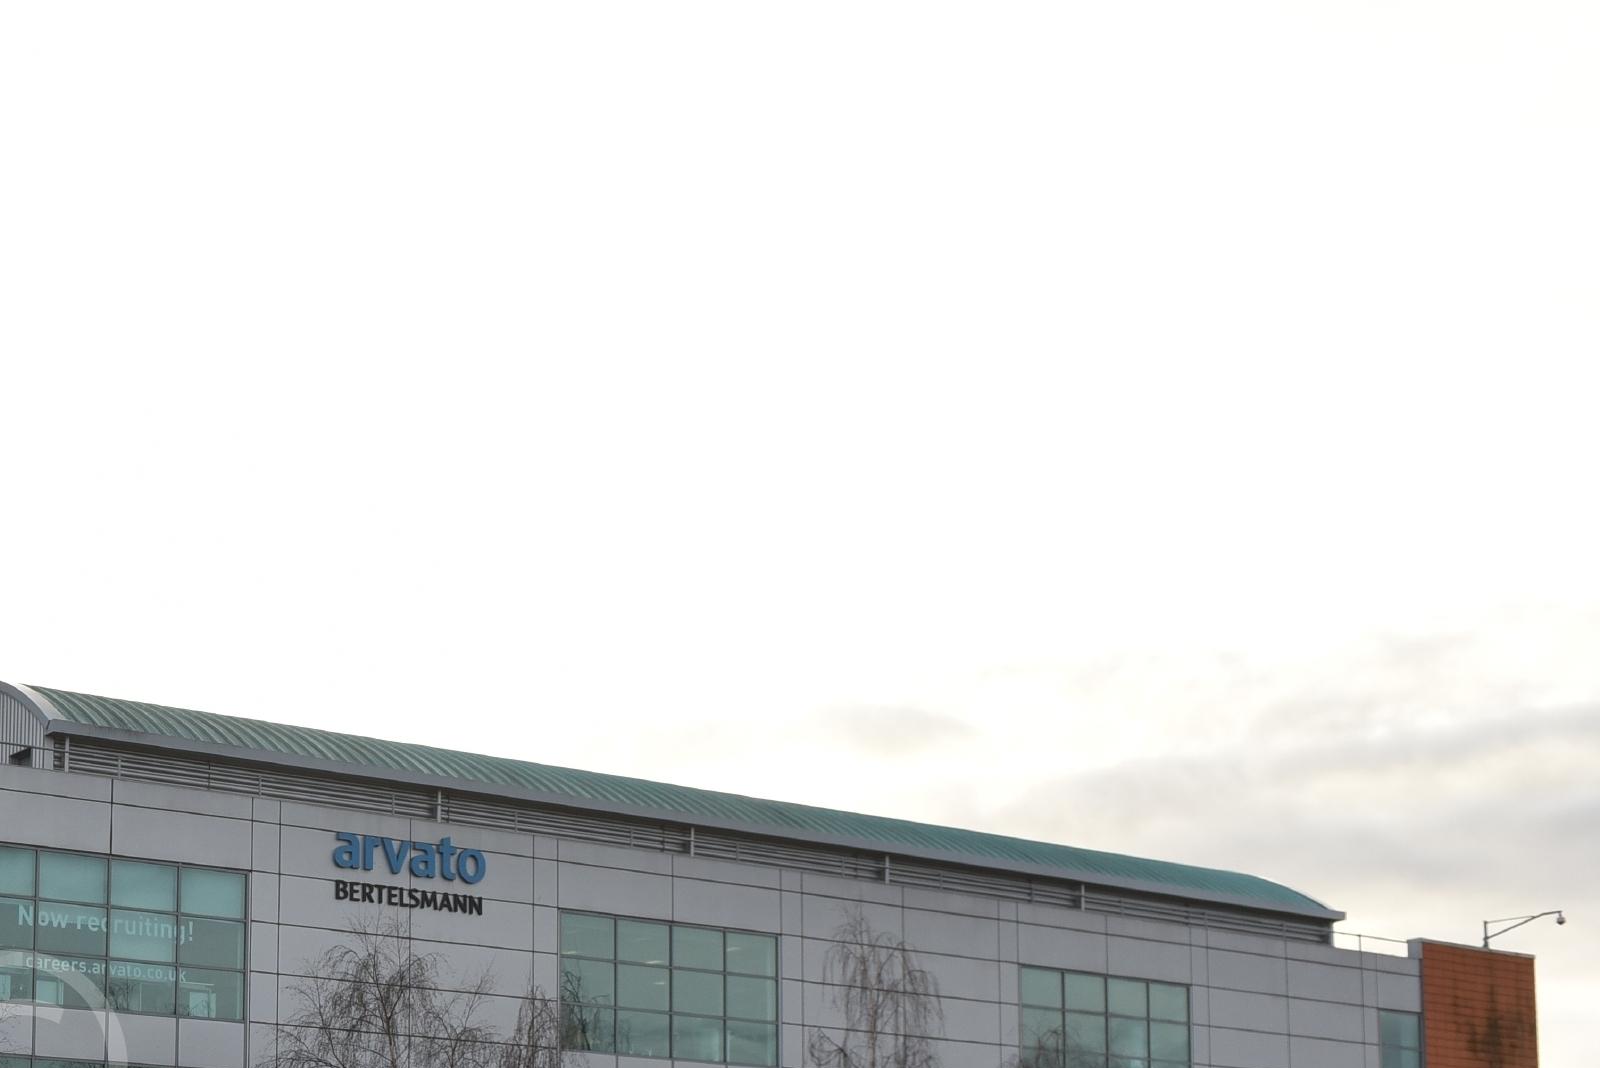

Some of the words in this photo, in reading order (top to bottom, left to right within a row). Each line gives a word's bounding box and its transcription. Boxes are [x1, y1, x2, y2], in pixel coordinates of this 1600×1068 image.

[333, 831, 487, 884] arvato
[335, 879, 483, 916] BERTELSMANN
[18, 903, 70, 929] Now
[76, 913, 194, 946] recruiting!
[26, 956, 187, 982] careers.arvato.co.uk
